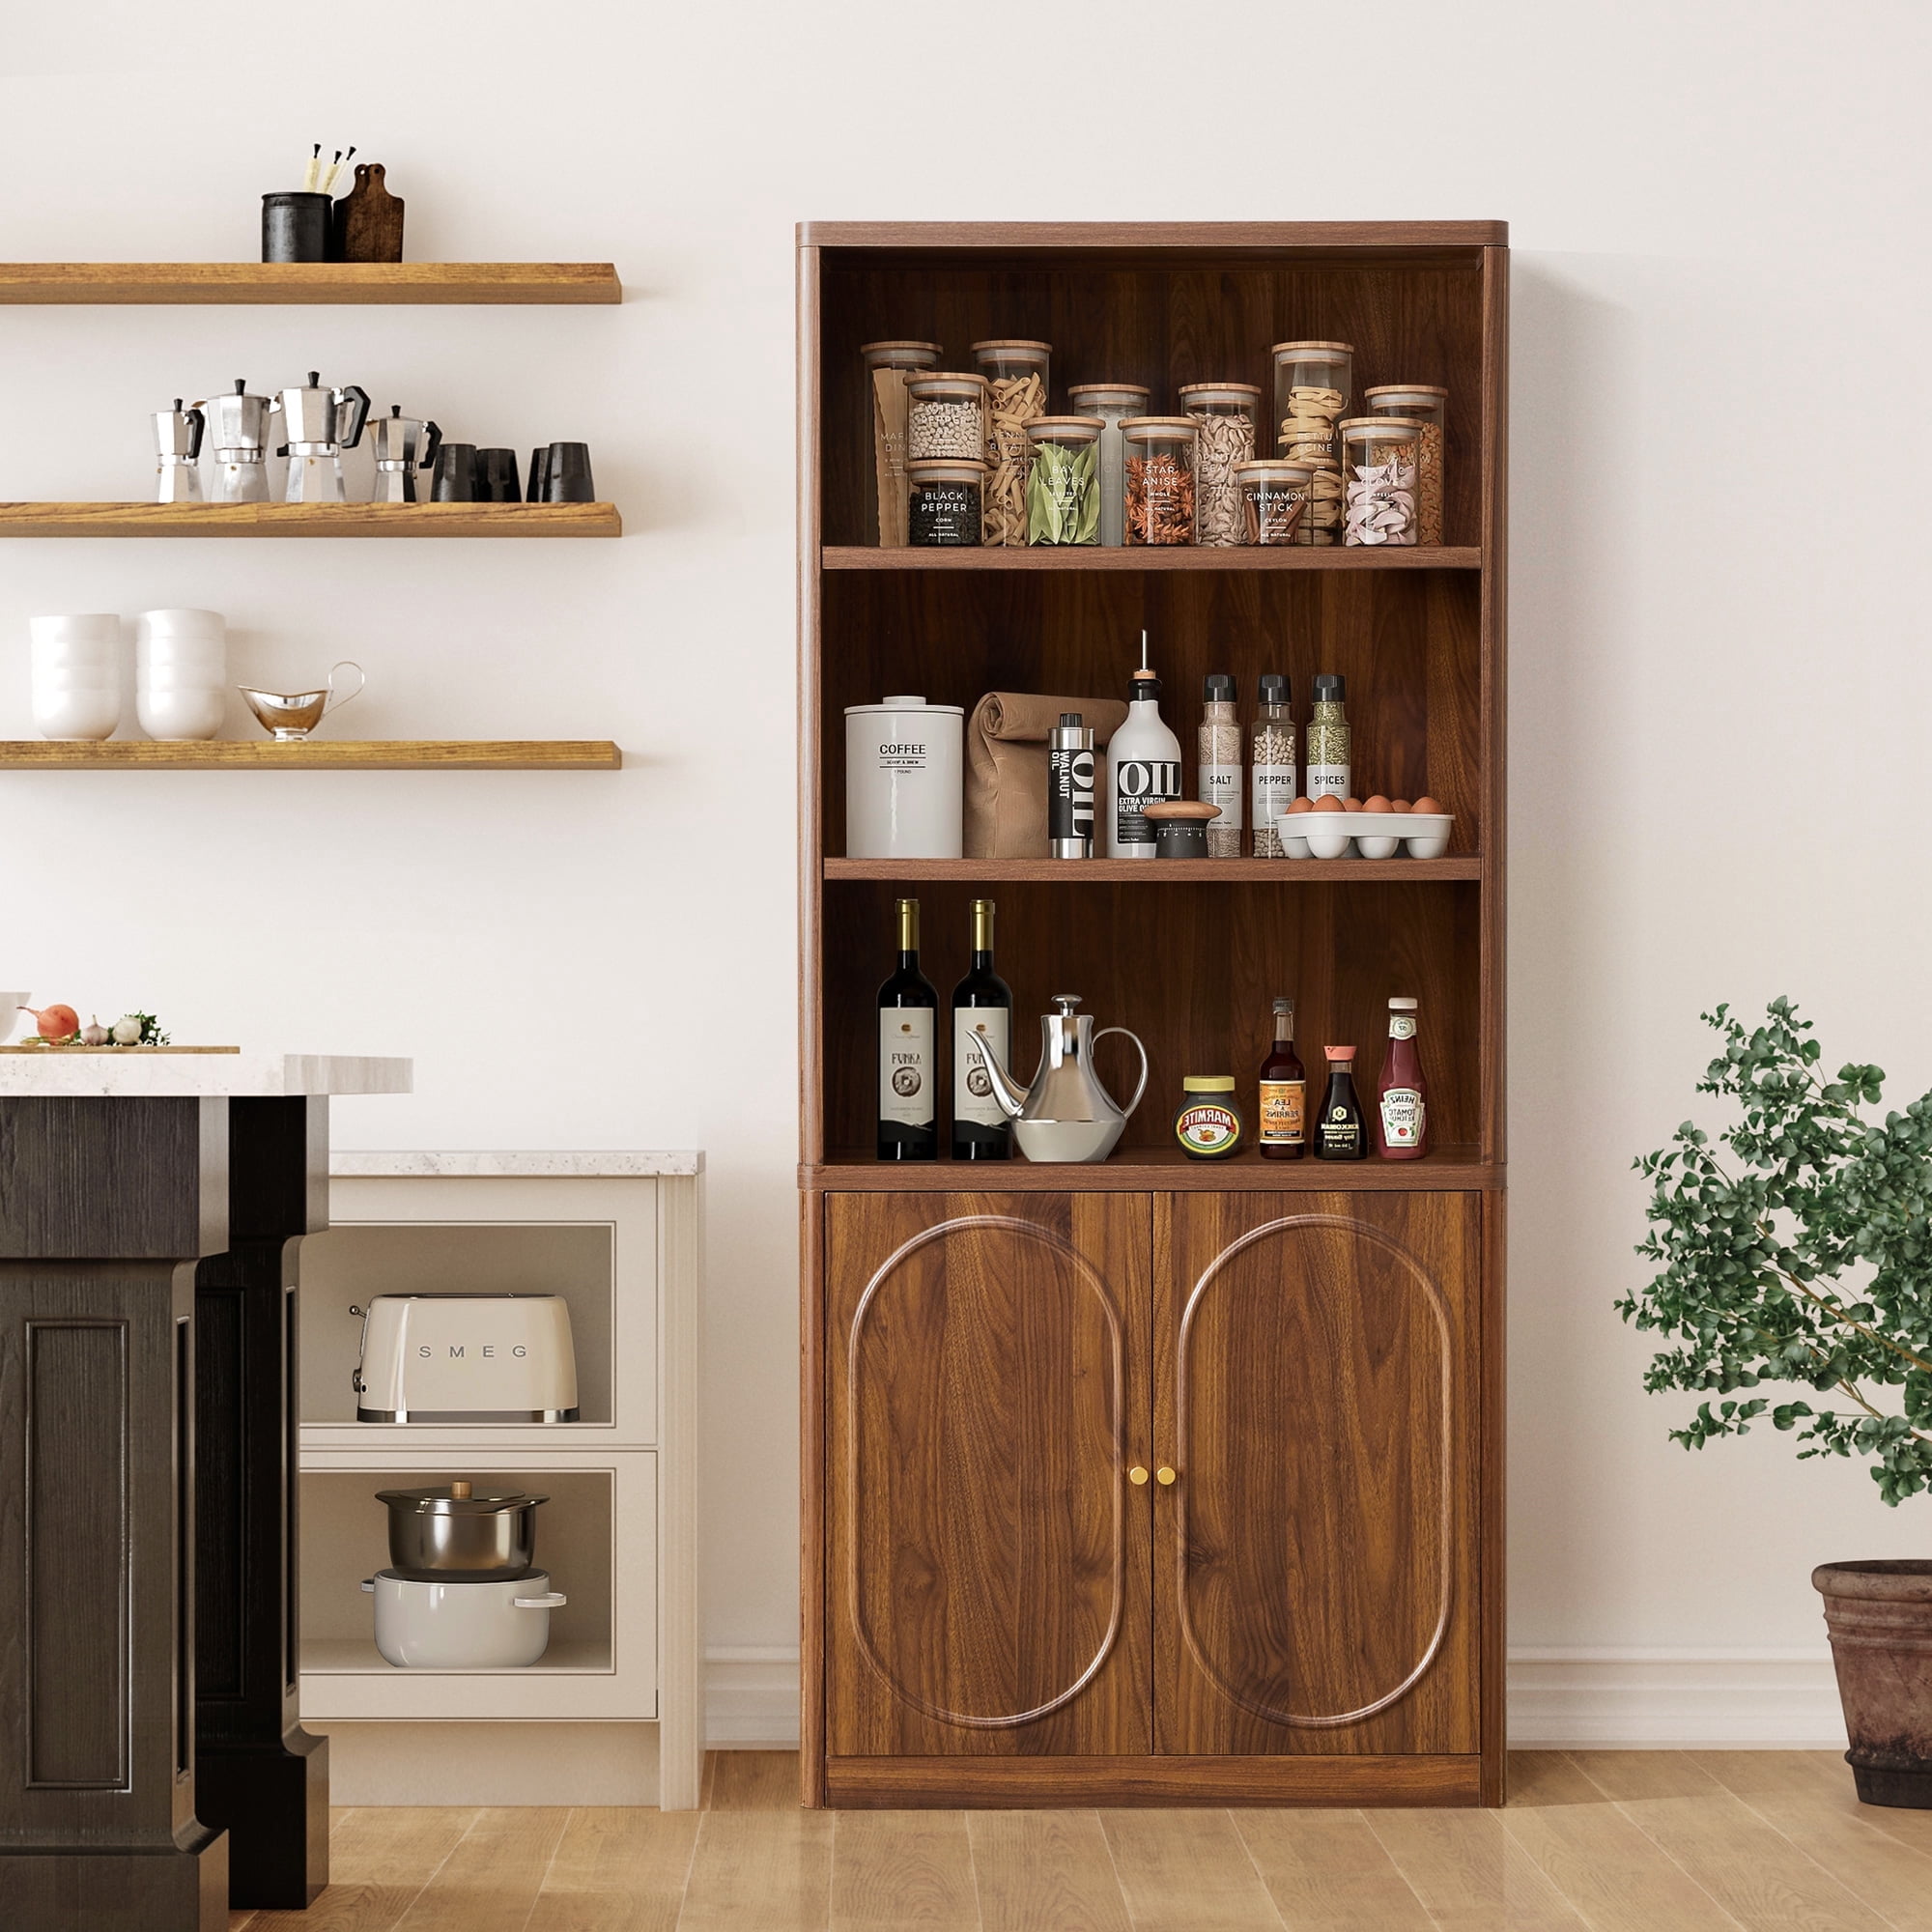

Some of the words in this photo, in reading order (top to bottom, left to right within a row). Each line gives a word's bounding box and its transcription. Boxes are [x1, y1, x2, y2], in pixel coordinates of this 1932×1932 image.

[991, 431, 1024, 440] PENN
[885, 443, 906, 452] DIN
[990, 442, 1025, 452] RIGAT
[1296, 443, 1333, 453] CCINE
[1145, 466, 1175, 474] STAR
[1202, 464, 1234, 472] BEAN
[1038, 477, 1085, 486] LEAVES
[1142, 477, 1179, 486] ANISE
[1361, 478, 1406, 487] CLOVES
[924, 492, 964, 500] BLACK
[1246, 493, 1305, 501] CINNAMON
[921, 502, 967, 512] PEPPER
[1259, 503, 1293, 512] STICK
[879, 744, 926, 754] COFFEE
[1051, 752, 1060, 771] OIL
[1059, 752, 1070, 799] WALNUT
[1119, 762, 1180, 796] OIL
[1209, 776, 1232, 784] SALT
[1258, 776, 1292, 784] PEPPER
[1314, 776, 1346, 784] SPICES
[1072, 752, 1094, 837] OIL
[418, 1345, 526, 1358] SMEG
